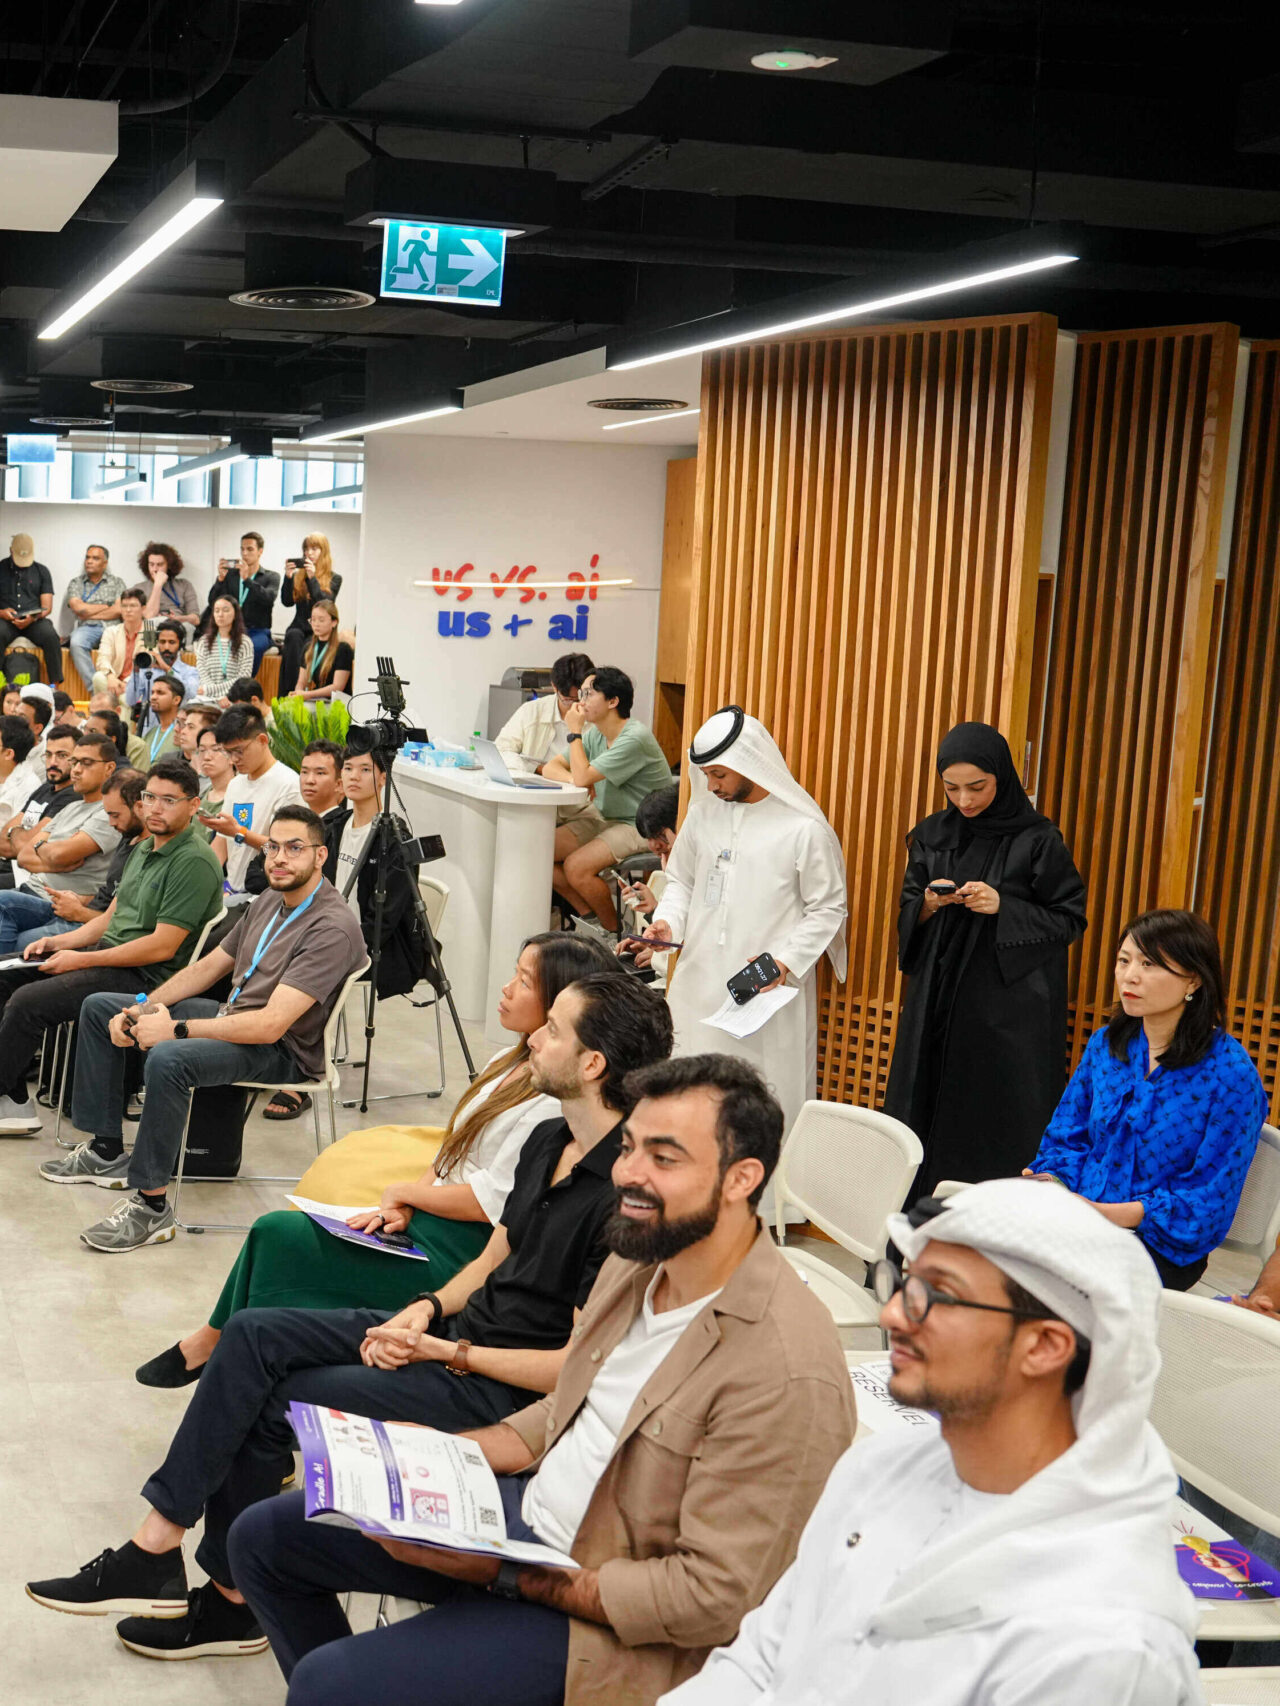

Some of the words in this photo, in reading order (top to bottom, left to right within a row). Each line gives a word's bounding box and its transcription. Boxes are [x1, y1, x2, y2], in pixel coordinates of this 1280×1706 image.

[432, 562, 474, 602] us
[490, 564, 547, 604] vs.
[565, 553, 600, 601] ai
[437, 610, 491, 638] us
[503, 613, 533, 637] +
[547, 604, 590, 641] ai
[849, 1371, 930, 1426] RESERVE
